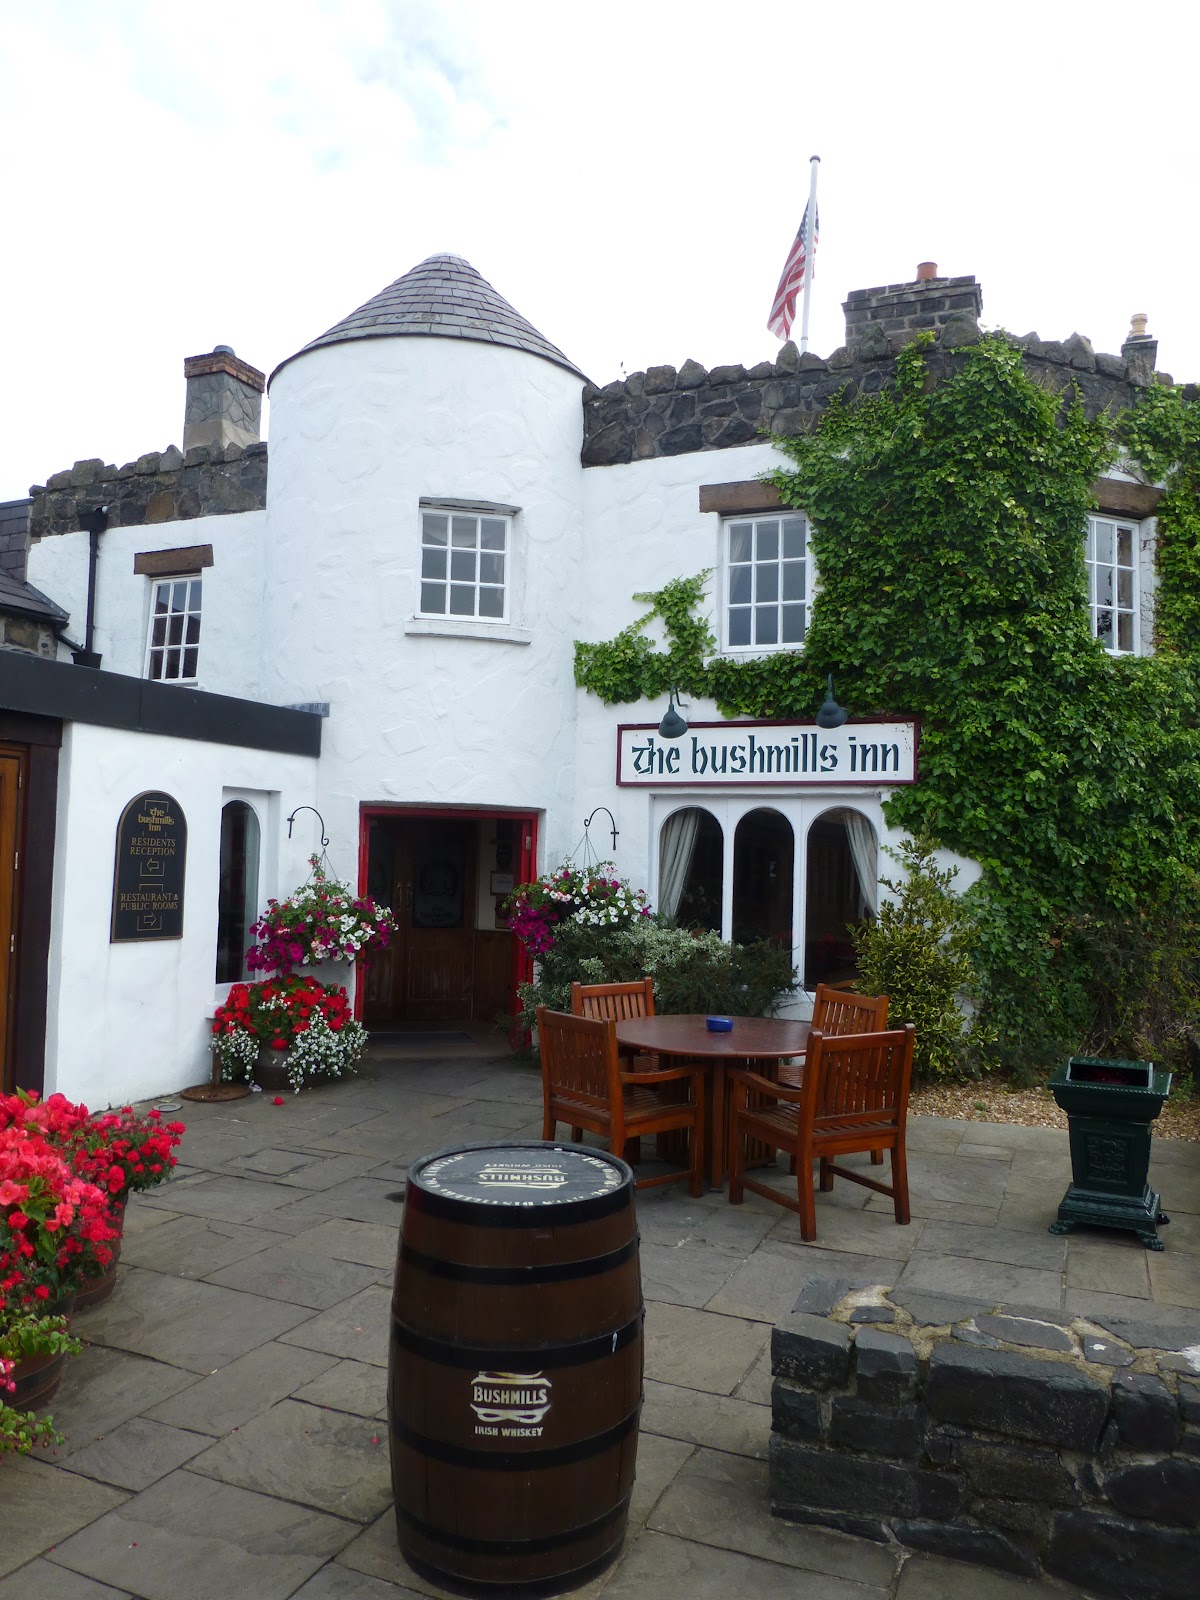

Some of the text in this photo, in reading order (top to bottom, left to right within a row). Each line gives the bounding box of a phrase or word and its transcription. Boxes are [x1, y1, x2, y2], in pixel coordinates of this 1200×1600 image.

[690, 733, 838, 775] bushmills
[848, 736, 899, 772] inn
[138, 814, 175, 826] bushmills
[131, 837, 176, 847] RESIDENTS
[130, 847, 175, 856] RECEPTION
[120, 892, 179, 902] RESTAURANT &
[120, 901, 178, 911] PUBLIC ROOMS
[479, 1173, 565, 1182] BUSHMILLS
[473, 1386, 548, 1405] BUSHMILLS
[475, 1425, 544, 1437] IRISH WHISKEY
